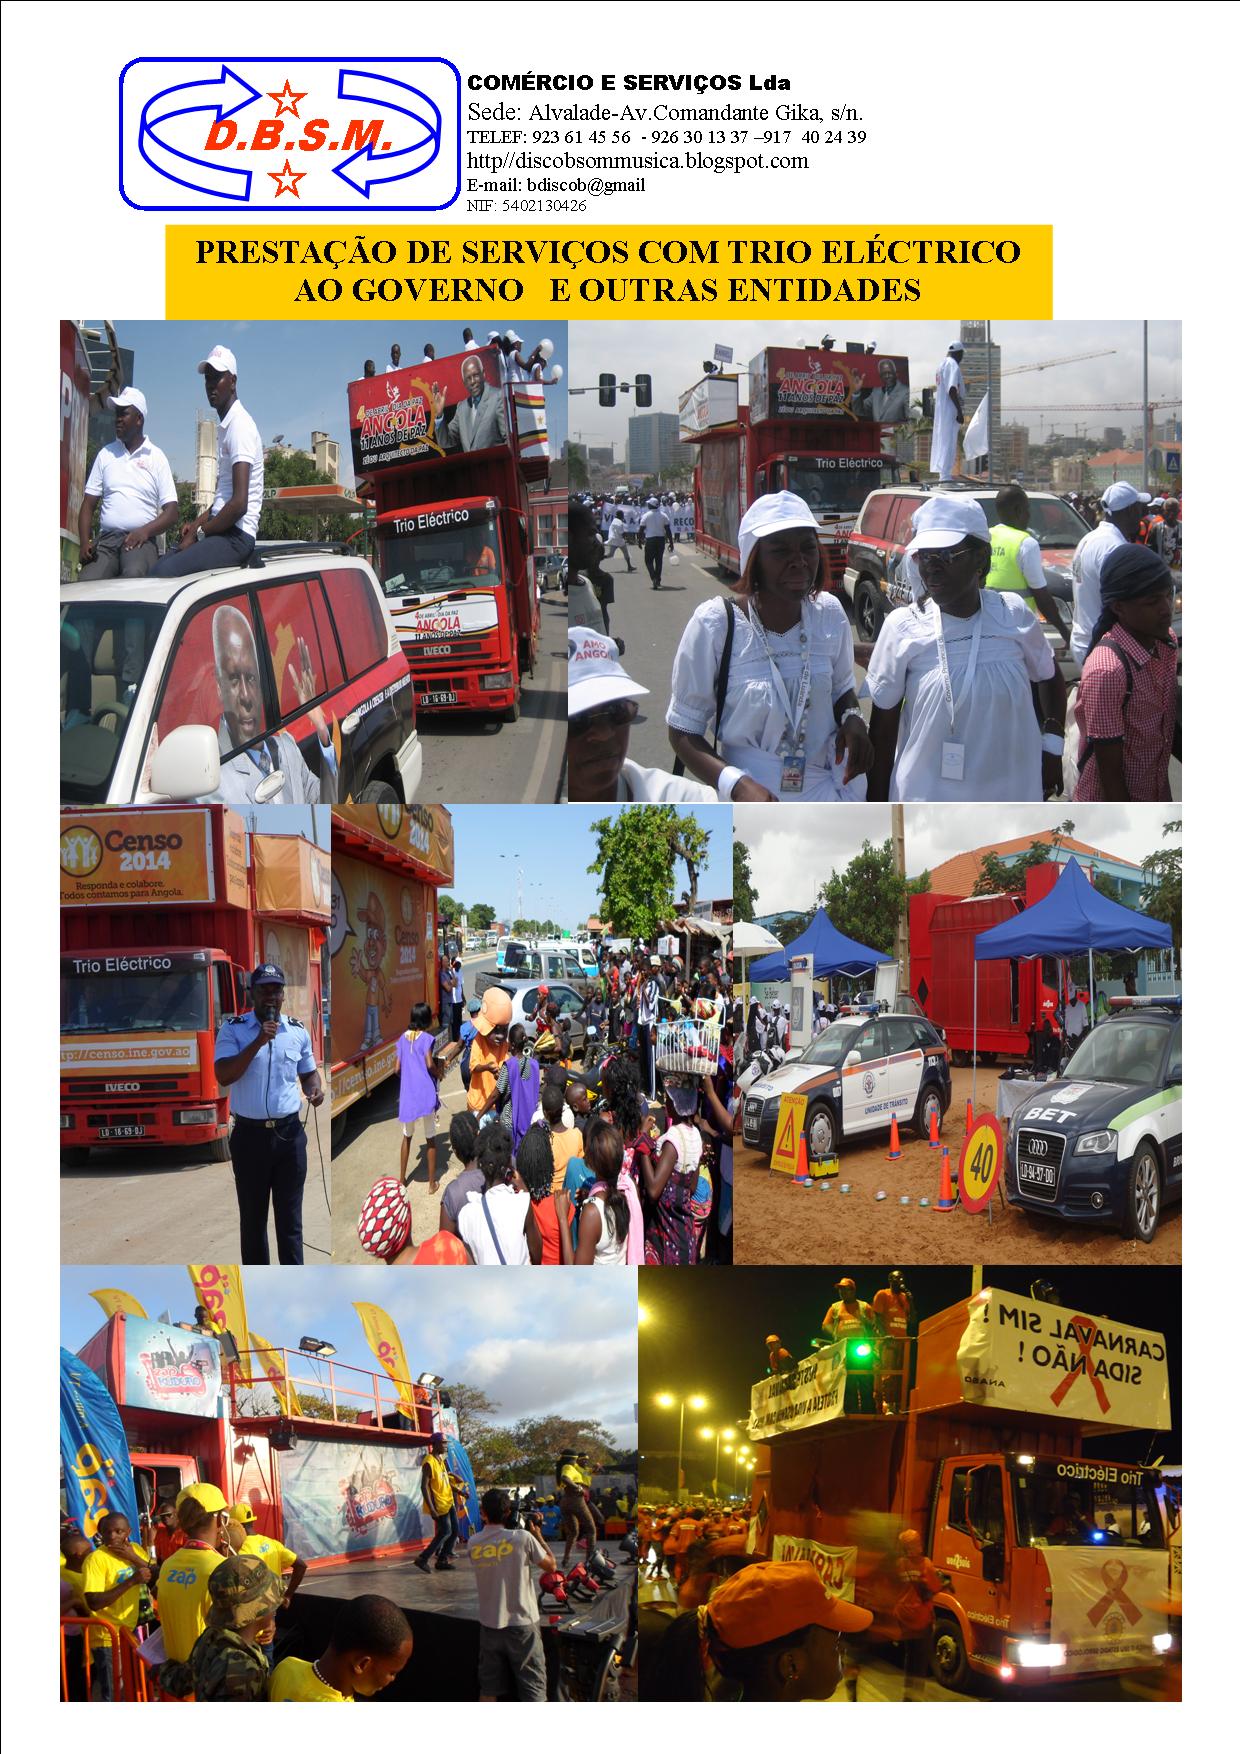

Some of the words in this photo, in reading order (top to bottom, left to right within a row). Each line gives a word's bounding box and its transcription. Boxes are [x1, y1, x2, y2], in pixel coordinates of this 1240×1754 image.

[468, 71, 593, 90] COMÉRCIO
[602, 75, 615, 90] E
[624, 75, 741, 94] SERVIÇOS
[750, 75, 790, 90] Lda
[469, 102, 520, 120] Sede:
[529, 104, 768, 120] Alvalade-Av.Comandante
[776, 104, 823, 123] Gika,
[832, 104, 862, 120] s/n.
[205, 119, 392, 150] D.B.S.M.
[467, 131, 526, 143] TELEF:
[533, 131, 559, 143] 923
[565, 131, 582, 143] 61
[589, 131, 605, 143] 45
[612, 131, 630, 143] 56
[652, 131, 678, 143] 926
[684, 131, 702, 143] 30
[709, 131, 725, 143] 13
[731, 131, 748, 143] 37
[802, 131, 819, 143] 40
[825, 131, 842, 143] 24
[848, 131, 866, 143] 39
[467, 152, 809, 173] http//discobsommusica.blogspot.com
[467, 178, 521, 191] E-mail:
[527, 178, 645, 196] bdiscob@gmail
[467, 200, 496, 211] NIF:
[503, 200, 586, 211] 5402130426
[196, 235, 396, 269] PRESTAÇÃO
[407, 241, 451, 263] DE
[463, 241, 628, 269] SERVIÇOS
[639, 241, 719, 263] COM
[728, 241, 811, 263] TRIO
[822, 234, 1020, 263] ELÉCTRICO
[294, 279, 342, 301] AO
[353, 279, 523, 301] GOVERNO
[550, 279, 570, 301] E
[580, 279, 717, 301] OUTRAS
[728, 279, 920, 301] ENTIDADES
[778, 378, 845, 395] ANGOLA
[357, 405, 366, 420] 4
[361, 405, 427, 438] ANGOLA
[361, 436, 370, 451] 11
[370, 432, 396, 449] ANOS
[396, 429, 409, 442] DE
[410, 424, 427, 440] PAZ
[815, 457, 834, 468] Trio
[839, 457, 883, 468] Eléctrico
[394, 517, 415, 534] Trio
[417, 509, 470, 529] Eléctrico
[415, 616, 461, 633] ANGOLA
[423, 645, 451, 656] IVECO
[583, 640, 606, 649] AMO
[105, 830, 182, 851] Censo
[120, 851, 171, 872] 2014
[76, 881, 118, 891] Responda
[87, 890, 129, 899] contamos
[130, 890, 150, 899] para
[73, 959, 100, 974] Trio
[105, 957, 171, 972] Eléctrico
[105, 1082, 140, 1092] IVECO
[1023, 1107, 1077, 1124] BET
[970, 1142, 994, 1184] 40
[470, 1540, 513, 1562] zap
[166, 1568, 198, 1590] zap
